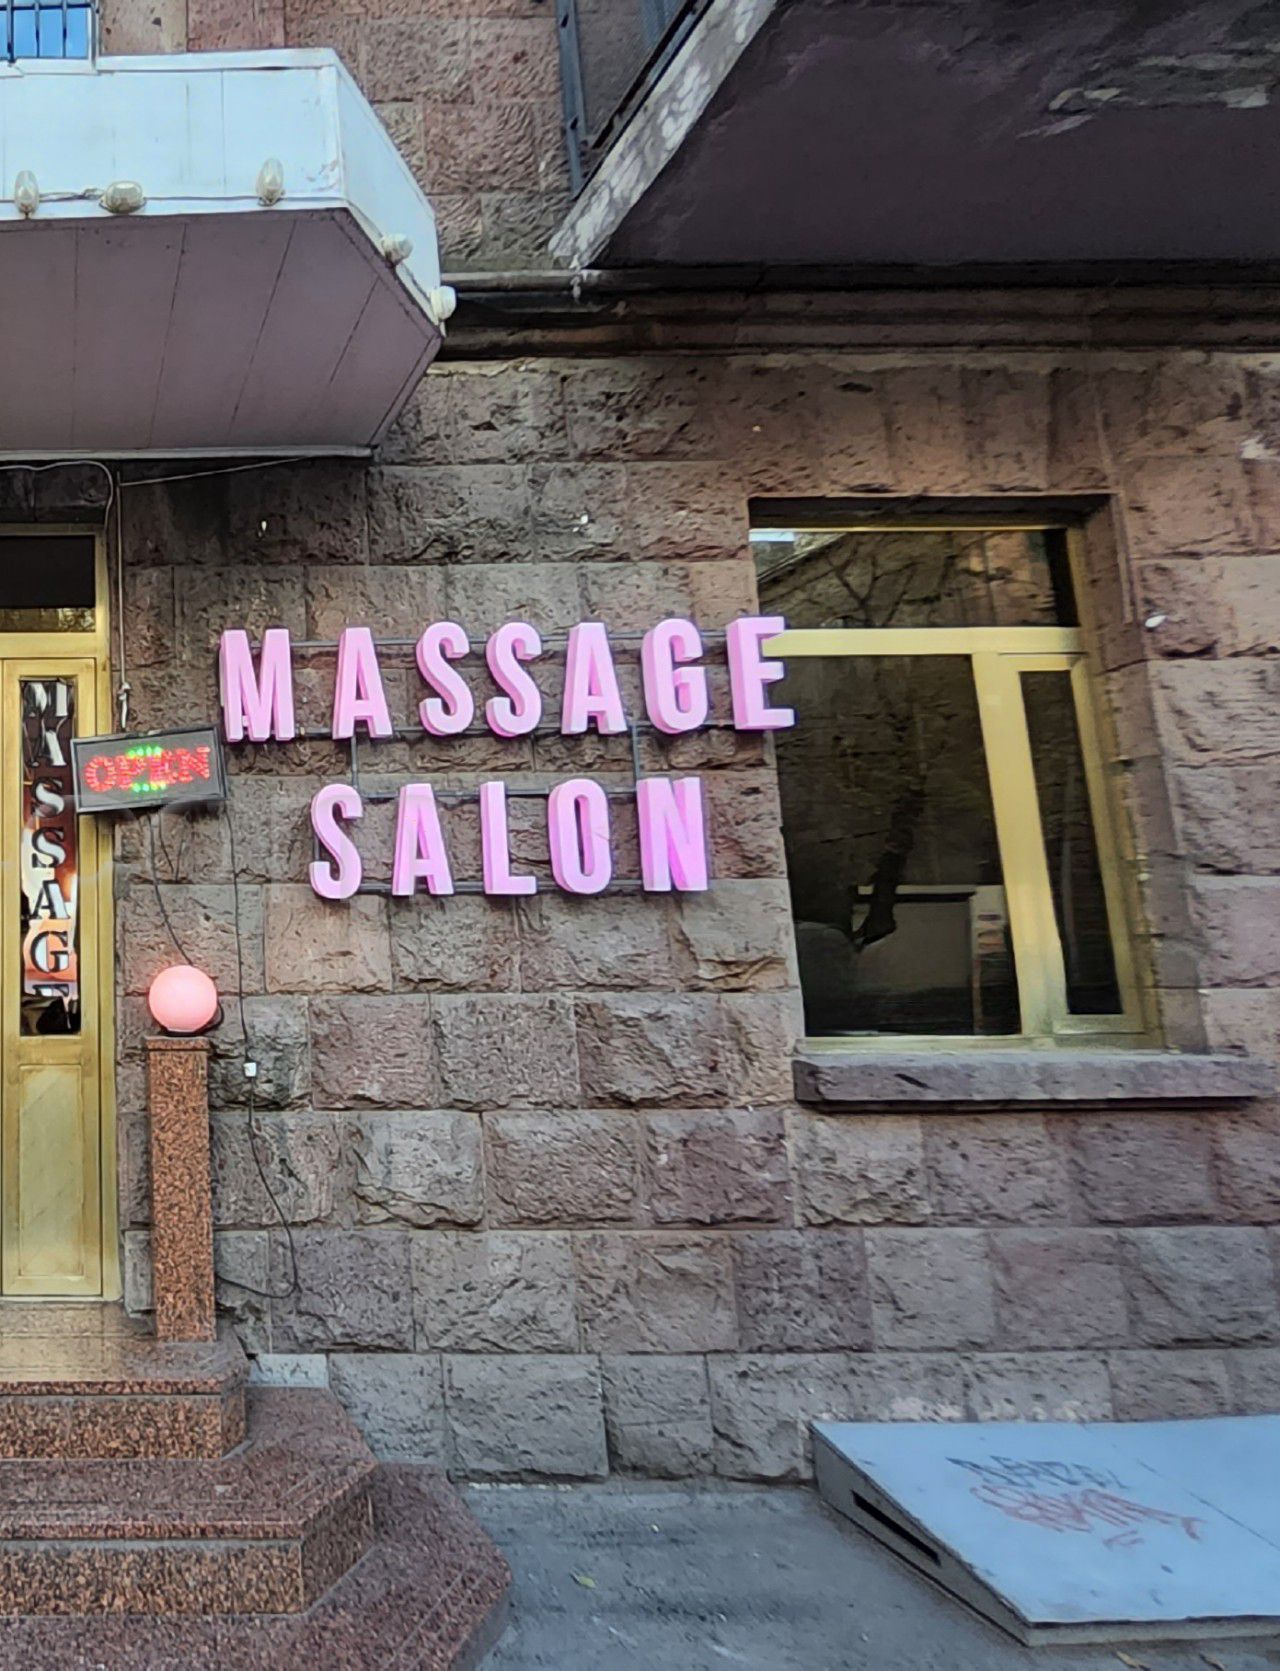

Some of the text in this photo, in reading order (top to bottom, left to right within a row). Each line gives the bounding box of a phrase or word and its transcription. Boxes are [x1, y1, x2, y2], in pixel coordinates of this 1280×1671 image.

[221, 616, 795, 742] MASSAGE
[84, 746, 211, 793] OPEN
[309, 776, 709, 899] SALON
